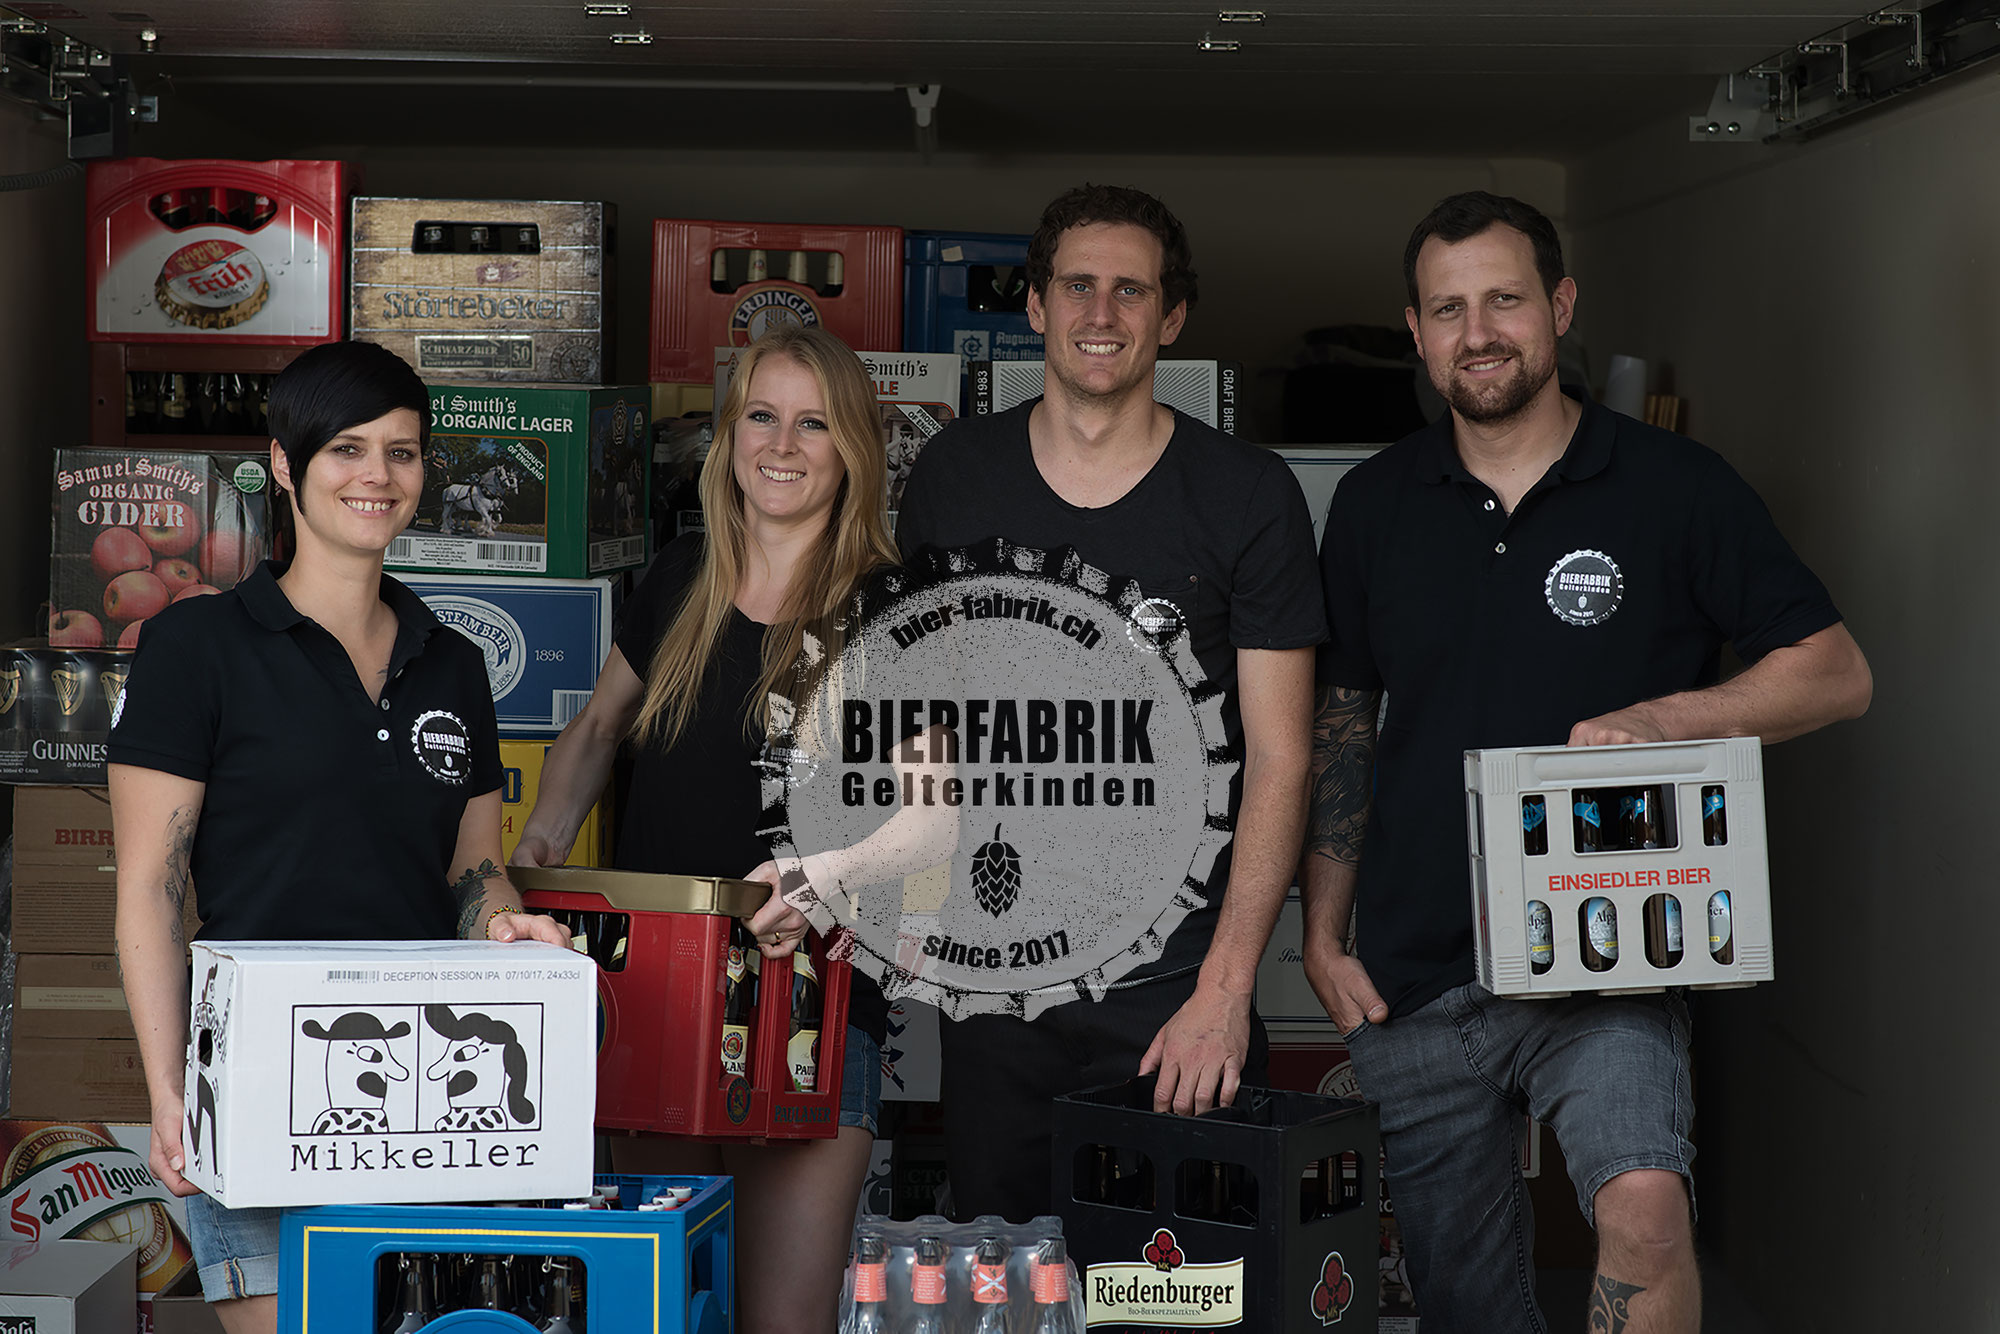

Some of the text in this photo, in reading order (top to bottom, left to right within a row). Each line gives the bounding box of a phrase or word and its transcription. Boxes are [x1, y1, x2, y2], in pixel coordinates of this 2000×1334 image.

[187, 261, 253, 295] Früh
[383, 291, 571, 320] Störtebeker
[736, 290, 816, 326] ERDINGER
[422, 344, 499, 356] SCHWARZ-BIER
[862, 359, 929, 380] Smith's
[977, 370, 988, 396] 1983
[1222, 369, 1234, 404] CRAFT
[450, 394, 517, 415] Smith's
[441, 413, 516, 431] ORGANIC
[520, 416, 573, 433] LAGER
[908, 411, 934, 437] OF ENGL
[507, 444, 545, 481] OF ENGLAND
[514, 441, 545, 471] PRODUCT
[57, 457, 204, 495] Samuel Smith's
[241, 468, 260, 476] USDA
[89, 483, 174, 500] ORGANIC
[77, 500, 185, 527] CIDER
[1560, 572, 1611, 587] BIERFABRIK
[436, 610, 481, 634] STEAM
[480, 623, 511, 654] BEER
[535, 649, 565, 662] 1896
[32, 739, 109, 762] GUINNES
[1548, 867, 1711, 891] EINSIEDLER BIER
[1707, 904, 1724, 916] ier
[383, 971, 438, 982] DECEPTION
[440, 970, 483, 981] SESSION
[485, 970, 500, 981] IPA
[547, 970, 581, 981] 24x33cl
[774, 1105, 832, 1123] PAULANER
[15, 1131, 106, 1176] CERVEZA INTERNACIONA
[290, 1139, 540, 1172] Mikkeller
[1094, 1275, 1235, 1312] Riedenburger
